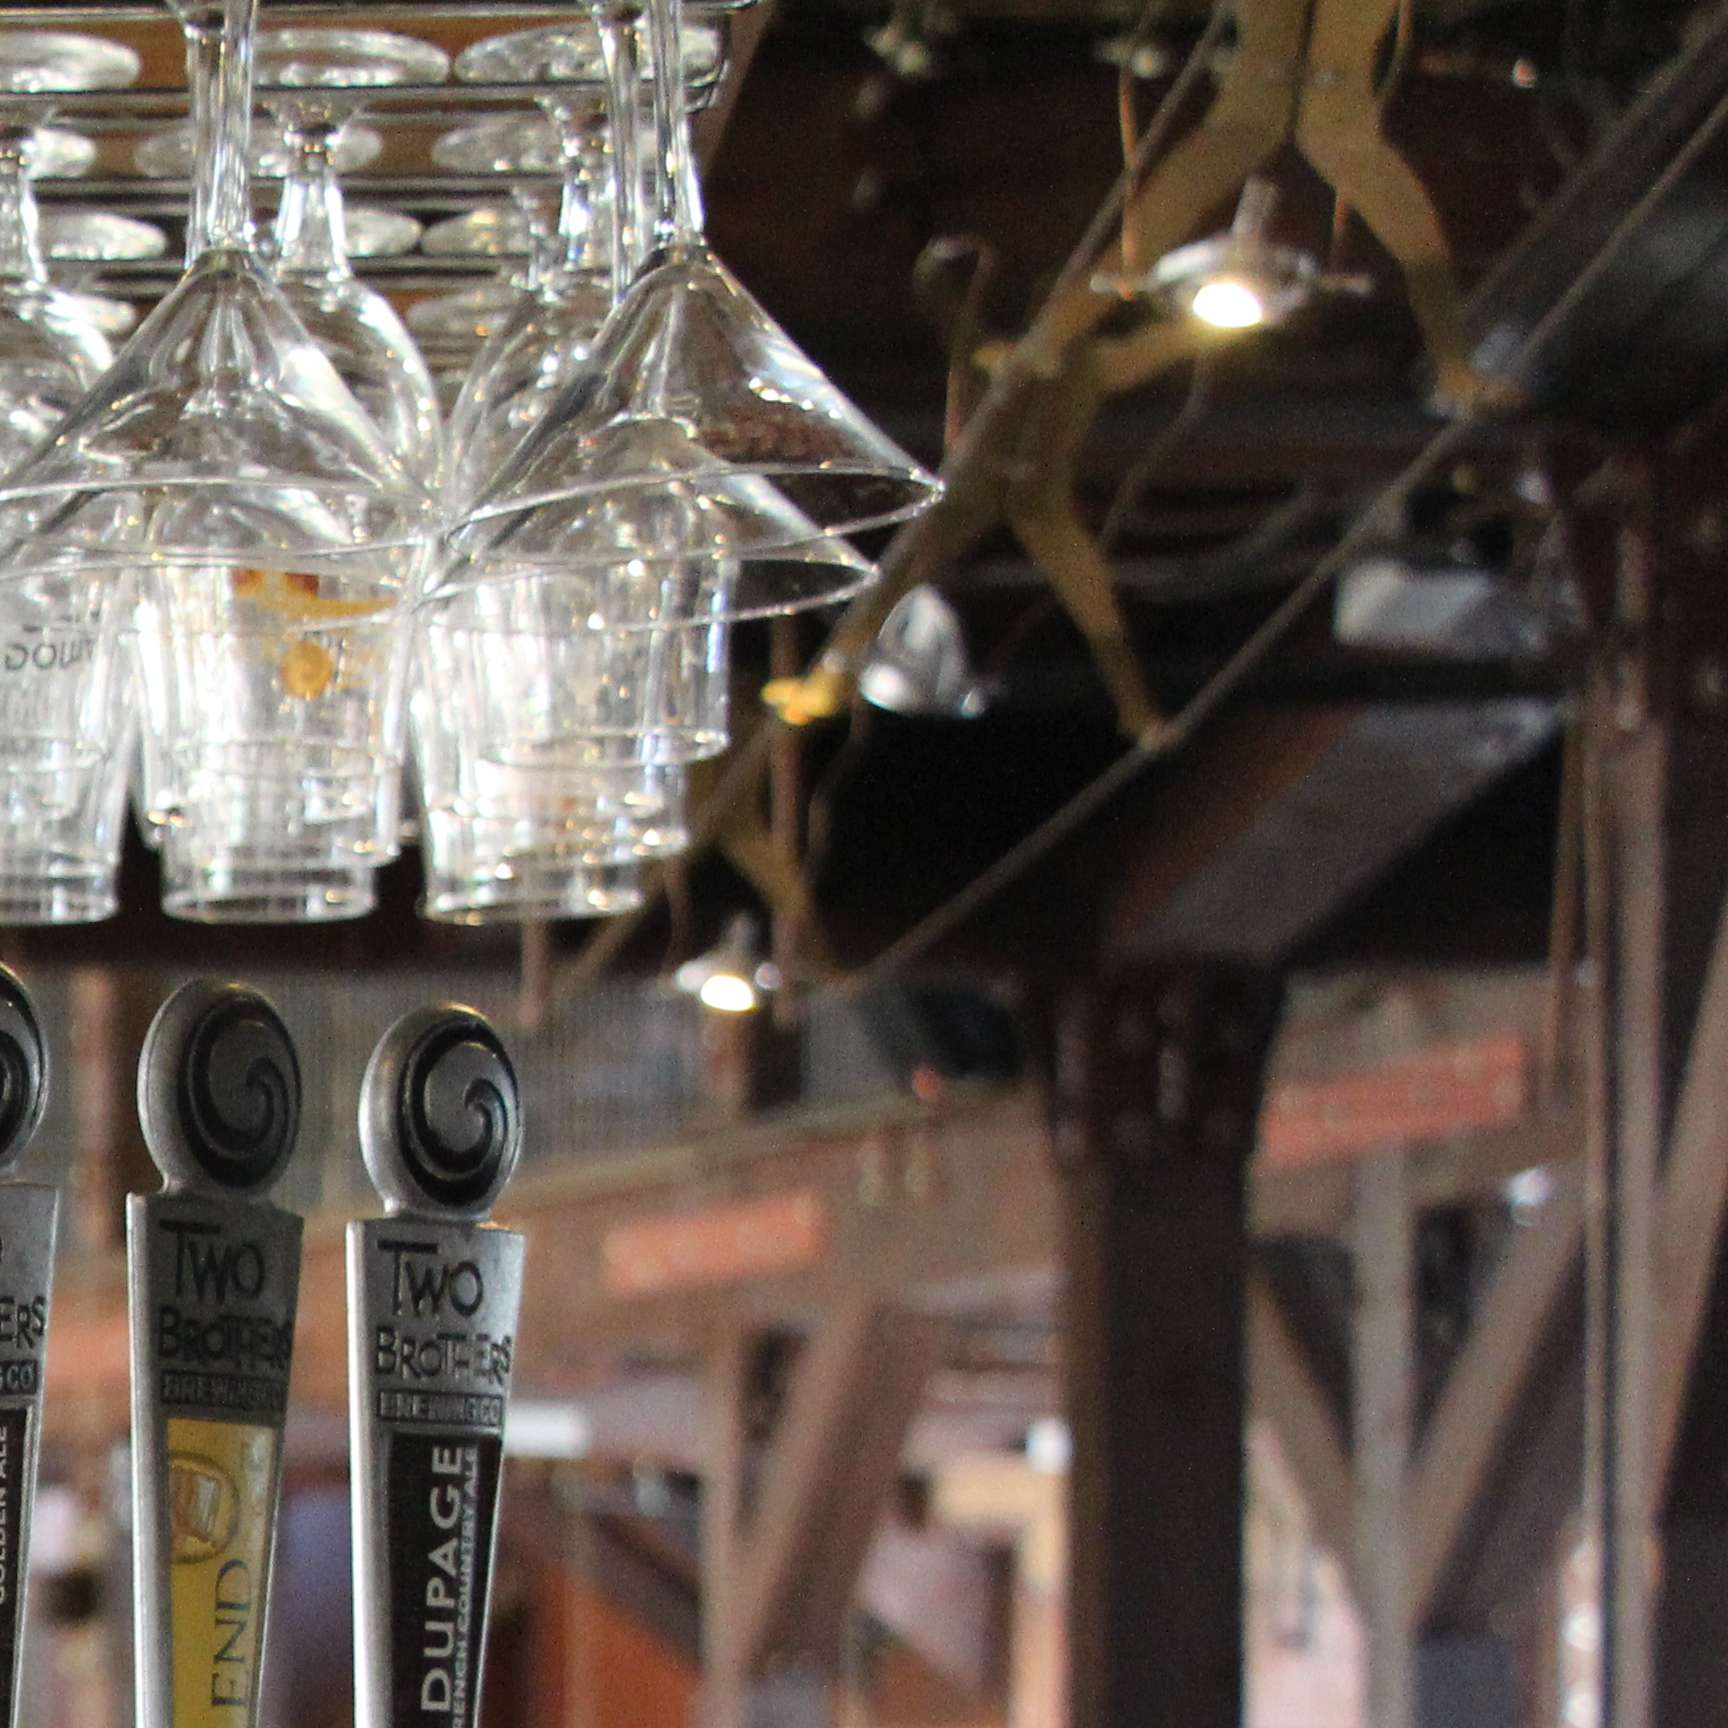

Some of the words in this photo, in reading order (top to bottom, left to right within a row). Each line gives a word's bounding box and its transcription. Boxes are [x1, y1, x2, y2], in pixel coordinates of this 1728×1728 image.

[158, 1220, 265, 1300] TWO
[377, 1239, 484, 1316] TWO
[464, 1447, 478, 1499] ALE
[421, 1446, 464, 1712] DUPAGE
[211, 1560, 250, 1708] END
